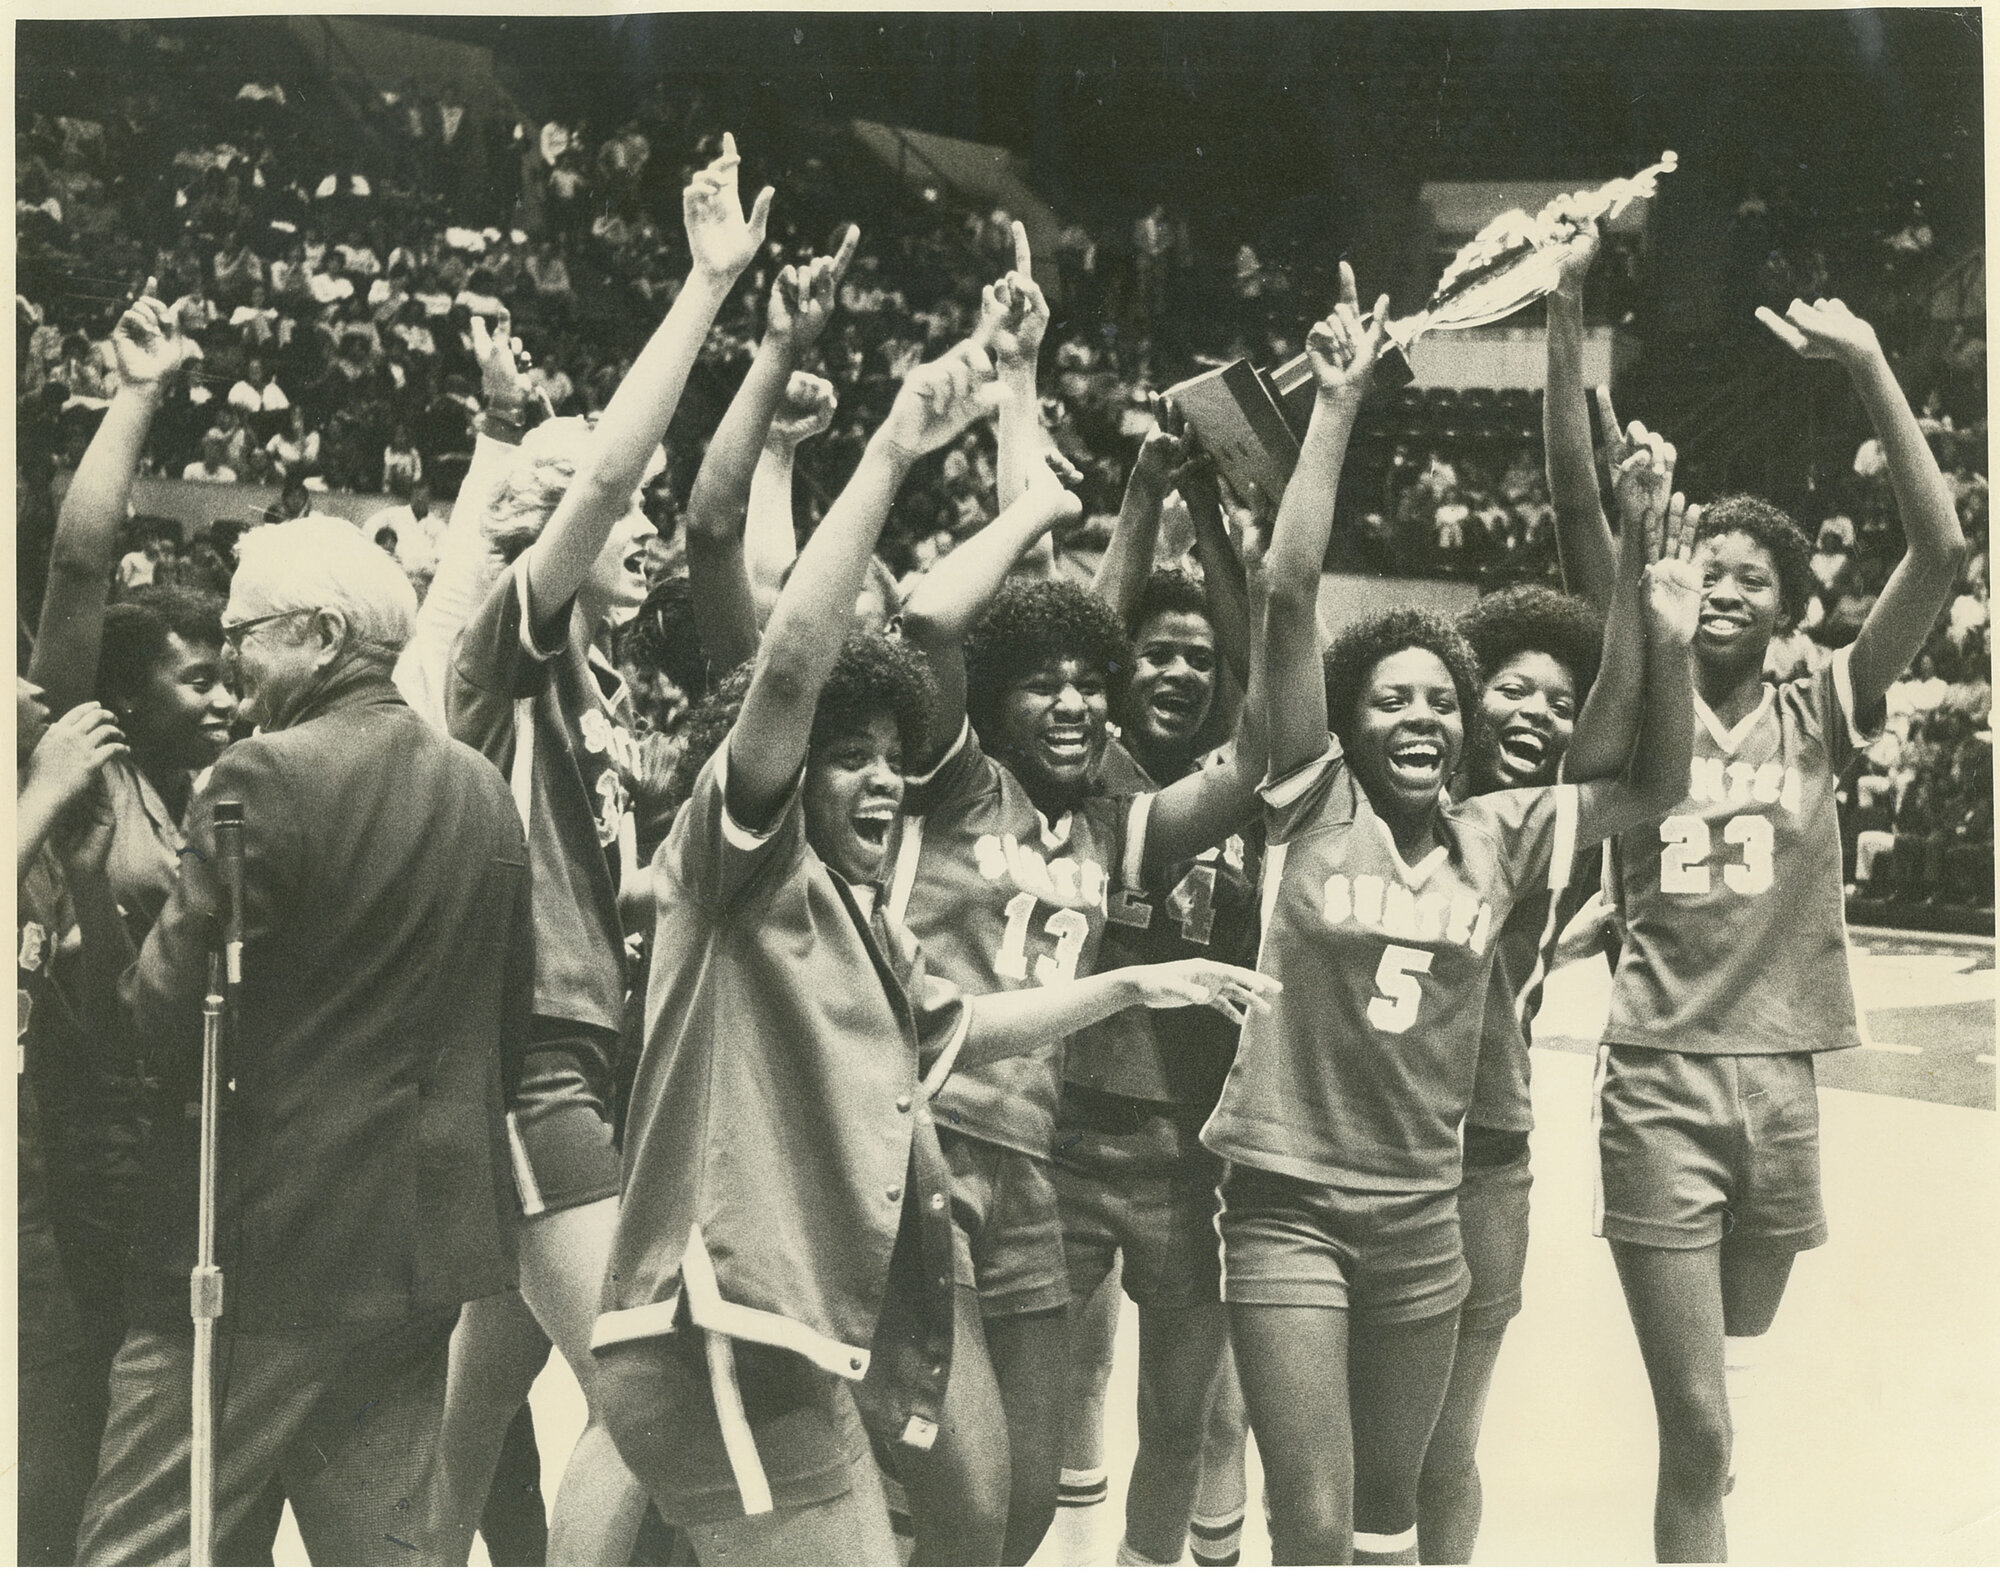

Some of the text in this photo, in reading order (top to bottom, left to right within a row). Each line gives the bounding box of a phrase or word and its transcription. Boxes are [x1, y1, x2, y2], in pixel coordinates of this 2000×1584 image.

[1660, 816, 1774, 894] 23
[994, 892, 1089, 986] 13
[1367, 944, 1434, 1033] 5
